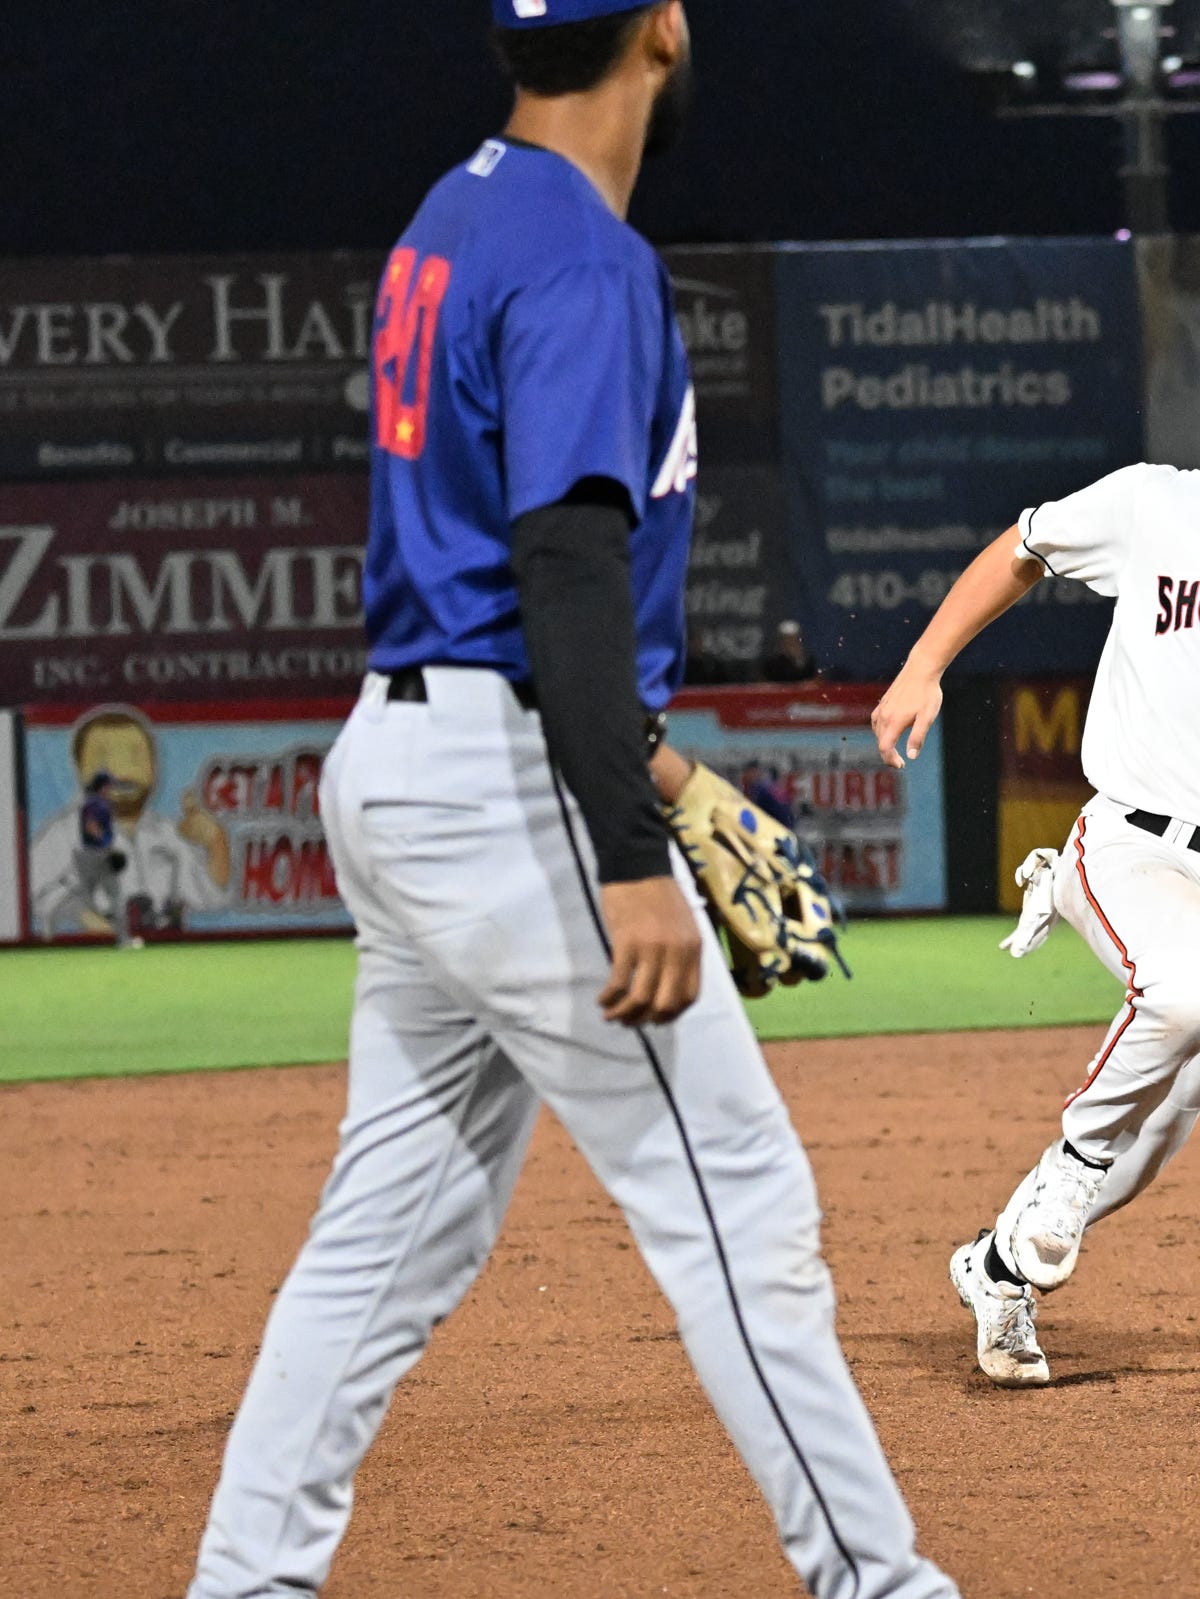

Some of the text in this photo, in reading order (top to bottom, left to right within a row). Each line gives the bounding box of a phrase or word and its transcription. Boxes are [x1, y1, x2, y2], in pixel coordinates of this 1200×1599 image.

[819, 297, 1101, 348] TidalHealth
[821, 364, 1073, 410] Pediatrics
[108, 501, 254, 531] JOSEPH
[0, 523, 368, 641] ZIMME
[33, 658, 109, 689] INC.
